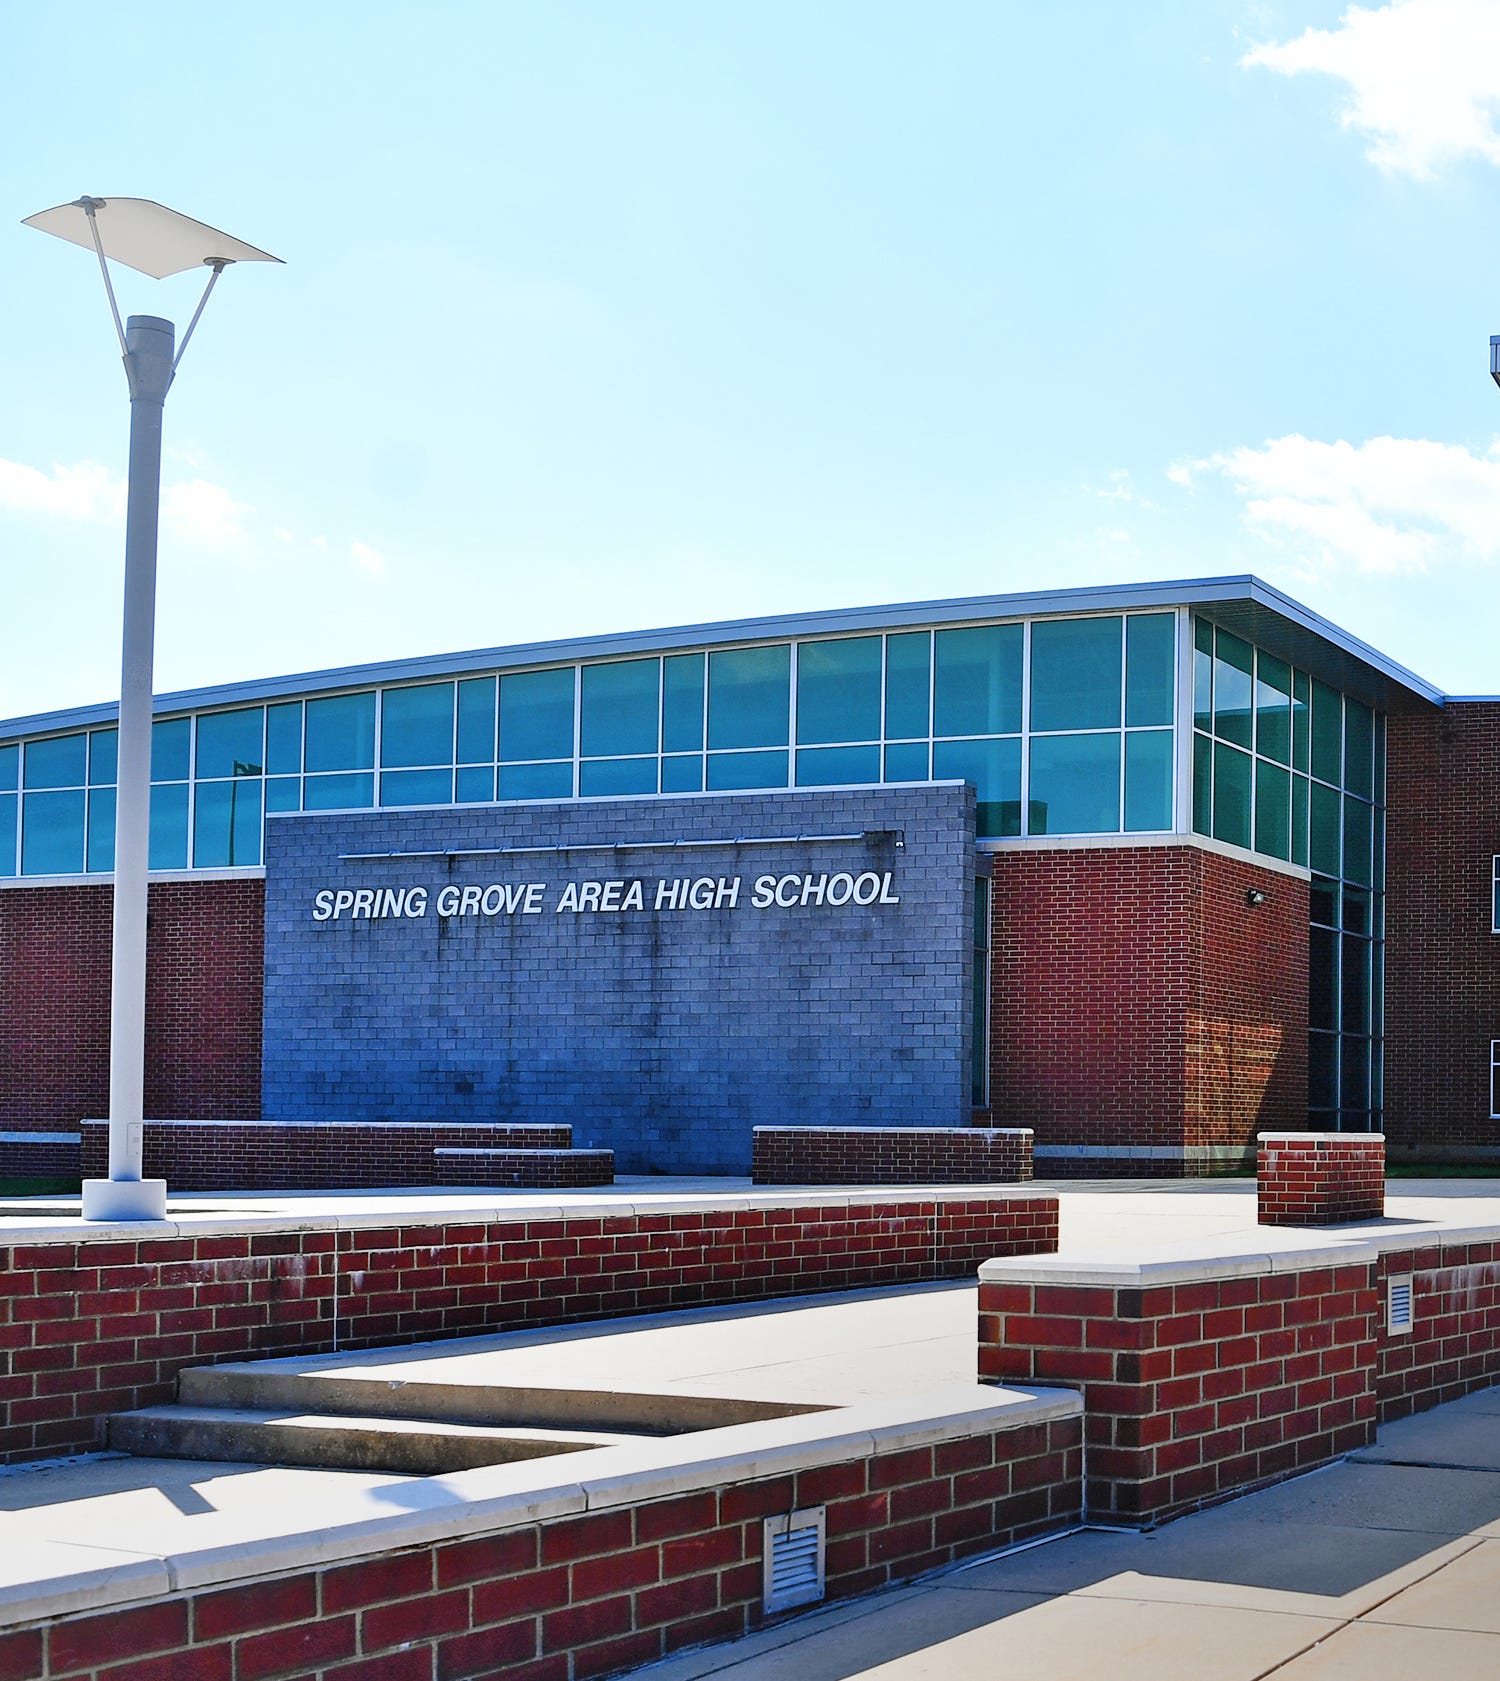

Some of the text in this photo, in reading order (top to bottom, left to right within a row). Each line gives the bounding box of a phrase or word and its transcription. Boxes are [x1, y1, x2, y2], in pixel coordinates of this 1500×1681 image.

[312, 872, 900, 921] SPRING GROVE AREA HIGH SCHOOL
